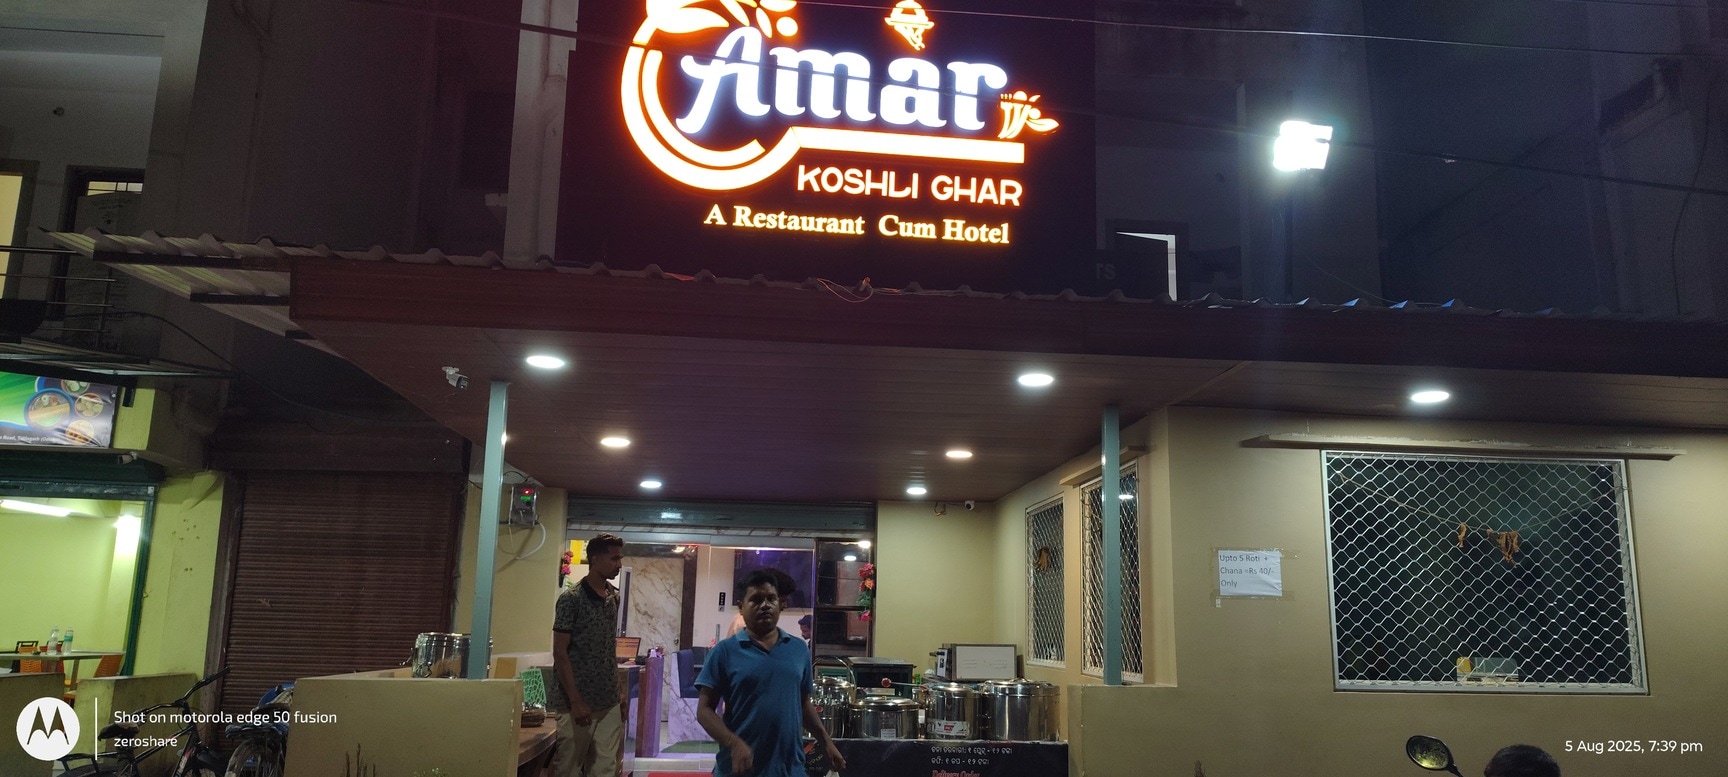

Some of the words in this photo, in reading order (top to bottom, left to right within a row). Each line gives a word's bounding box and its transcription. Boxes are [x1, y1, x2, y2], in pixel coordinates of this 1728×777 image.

[675, 26, 1008, 134] Amar
[797, 164, 919, 199] KOSHLI
[931, 174, 1023, 207] GHAR
[704, 204, 727, 226] A
[733, 205, 865, 236] Restaurant
[878, 215, 936, 240] Cum
[942, 219, 1010, 244] Hotel
